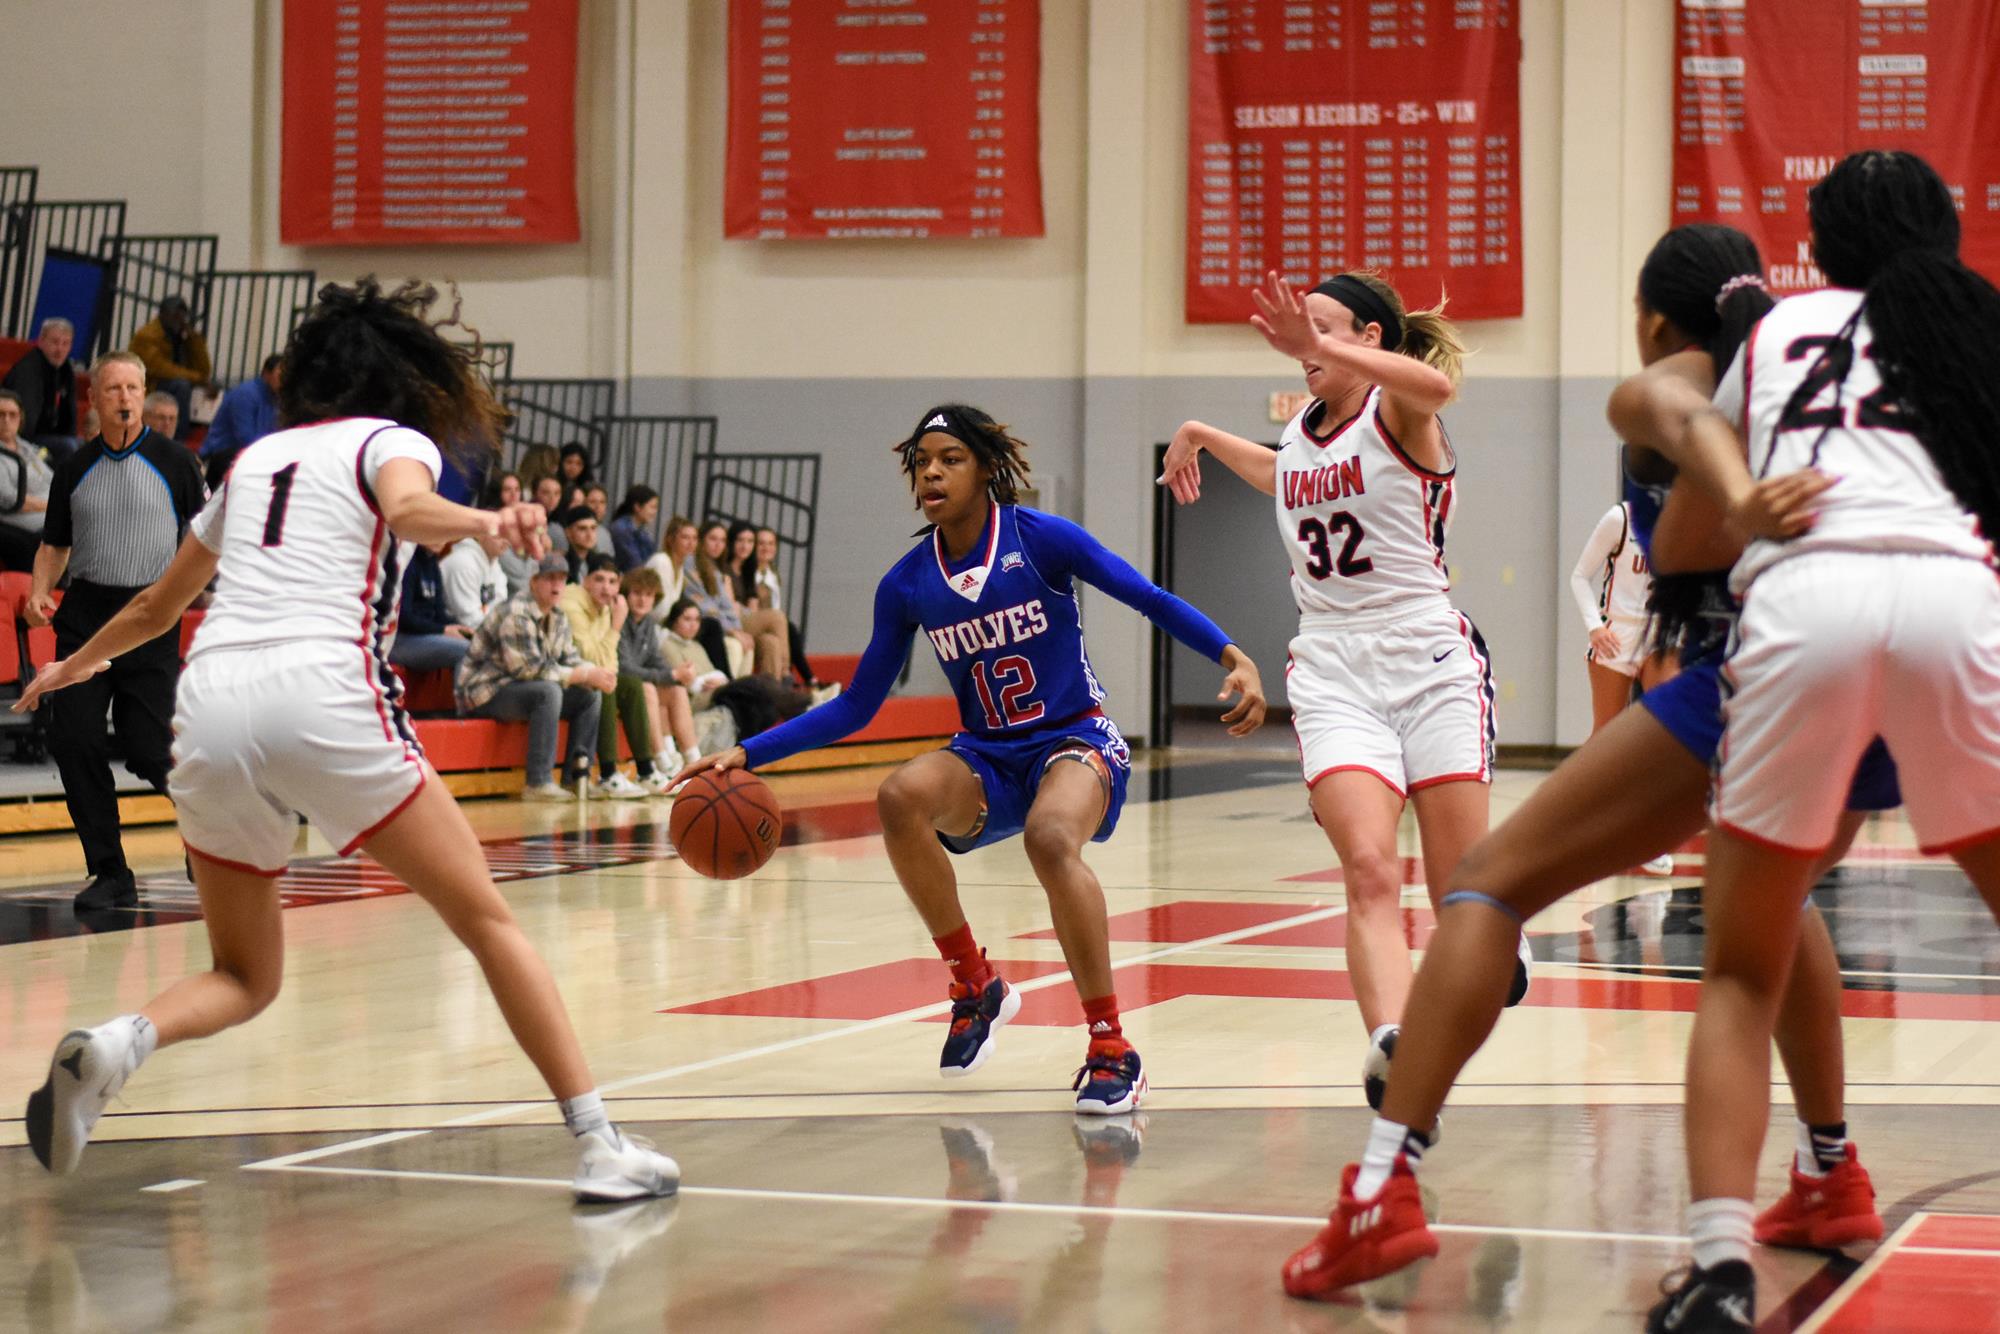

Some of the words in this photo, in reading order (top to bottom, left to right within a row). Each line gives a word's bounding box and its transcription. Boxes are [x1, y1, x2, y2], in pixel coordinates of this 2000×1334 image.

[1234, 106, 1299, 128] SEASON
[1304, 103, 1380, 127] RECORDS
[1436, 100, 1476, 124] WIN
[261, 461, 301, 548] 1
[1284, 455, 1365, 510] UNION
[1298, 510, 1374, 581] 32
[929, 599, 1048, 663] WOLVES
[971, 655, 1045, 729] 12
